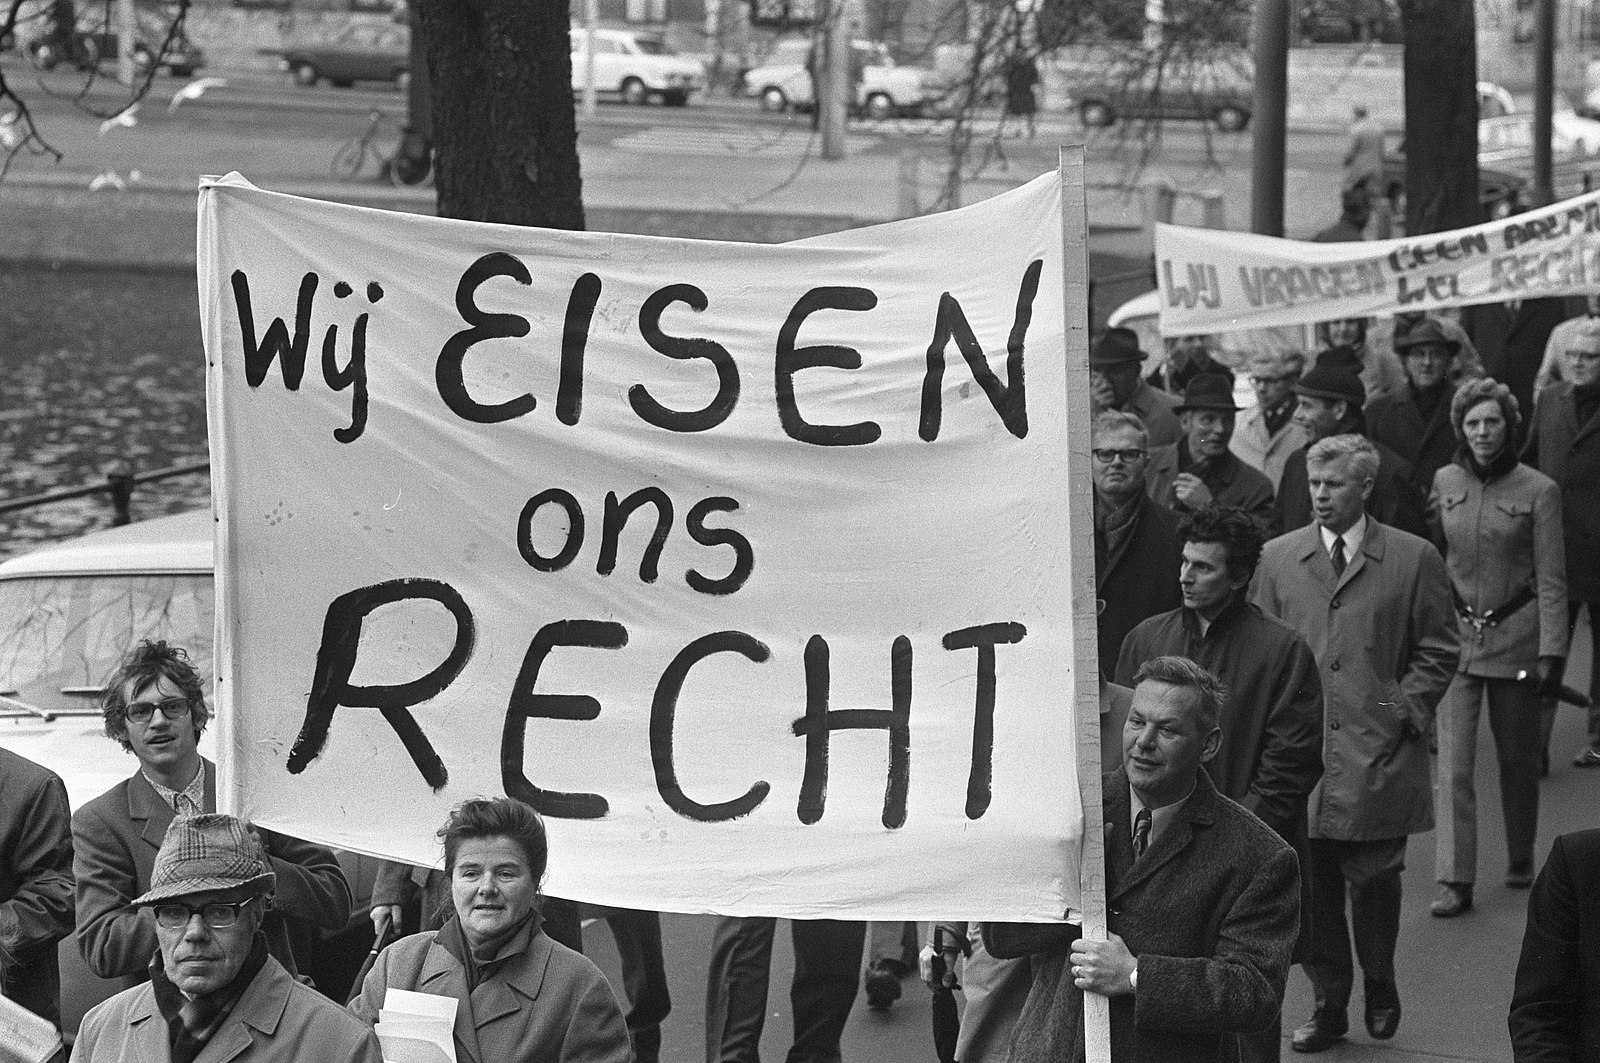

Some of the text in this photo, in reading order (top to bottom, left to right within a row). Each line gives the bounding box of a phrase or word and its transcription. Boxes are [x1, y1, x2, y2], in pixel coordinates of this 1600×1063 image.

[435, 251, 1044, 447] EISEN
[516, 486, 754, 596] ons
[286, 577, 1027, 829] RECHT
